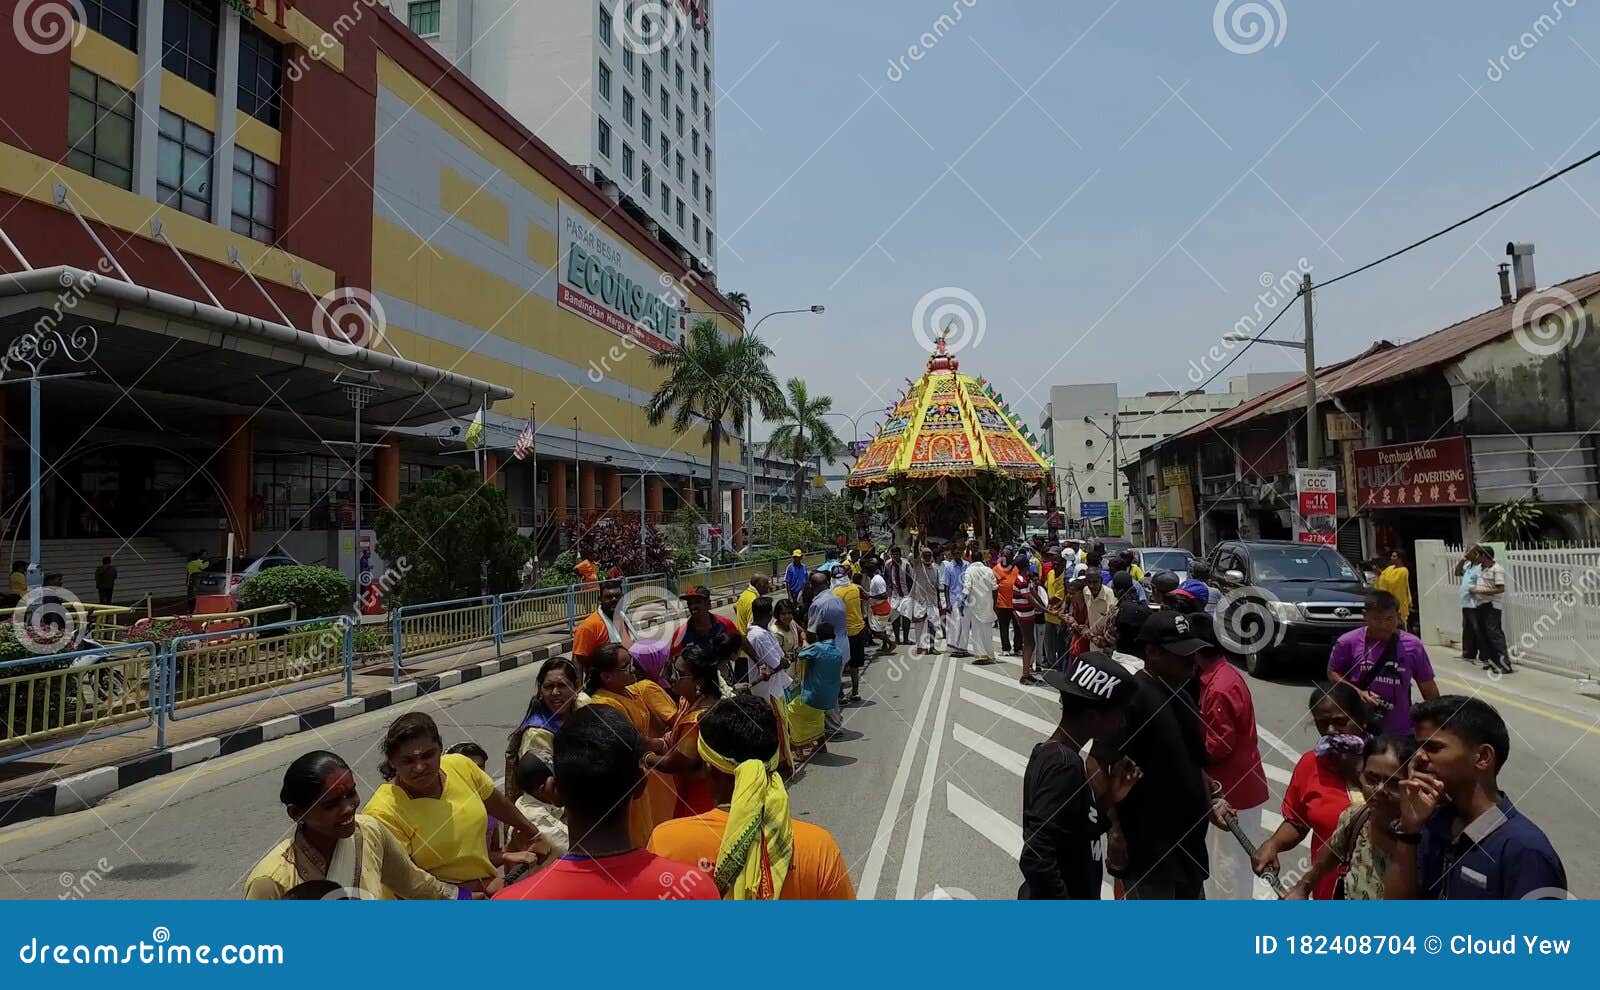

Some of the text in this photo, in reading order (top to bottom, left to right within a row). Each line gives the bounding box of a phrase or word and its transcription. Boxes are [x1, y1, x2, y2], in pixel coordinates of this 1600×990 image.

[566, 217, 622, 267] PASAR BESAR
[564, 289, 605, 320] Bandingkan
[606, 312, 625, 331] Harga
[567, 242, 678, 342] ECONSAVE
[1307, 478, 1326, 487] CCC
[1413, 468, 1465, 485] ADVERTISING
[1070, 660, 1121, 699] YORK
